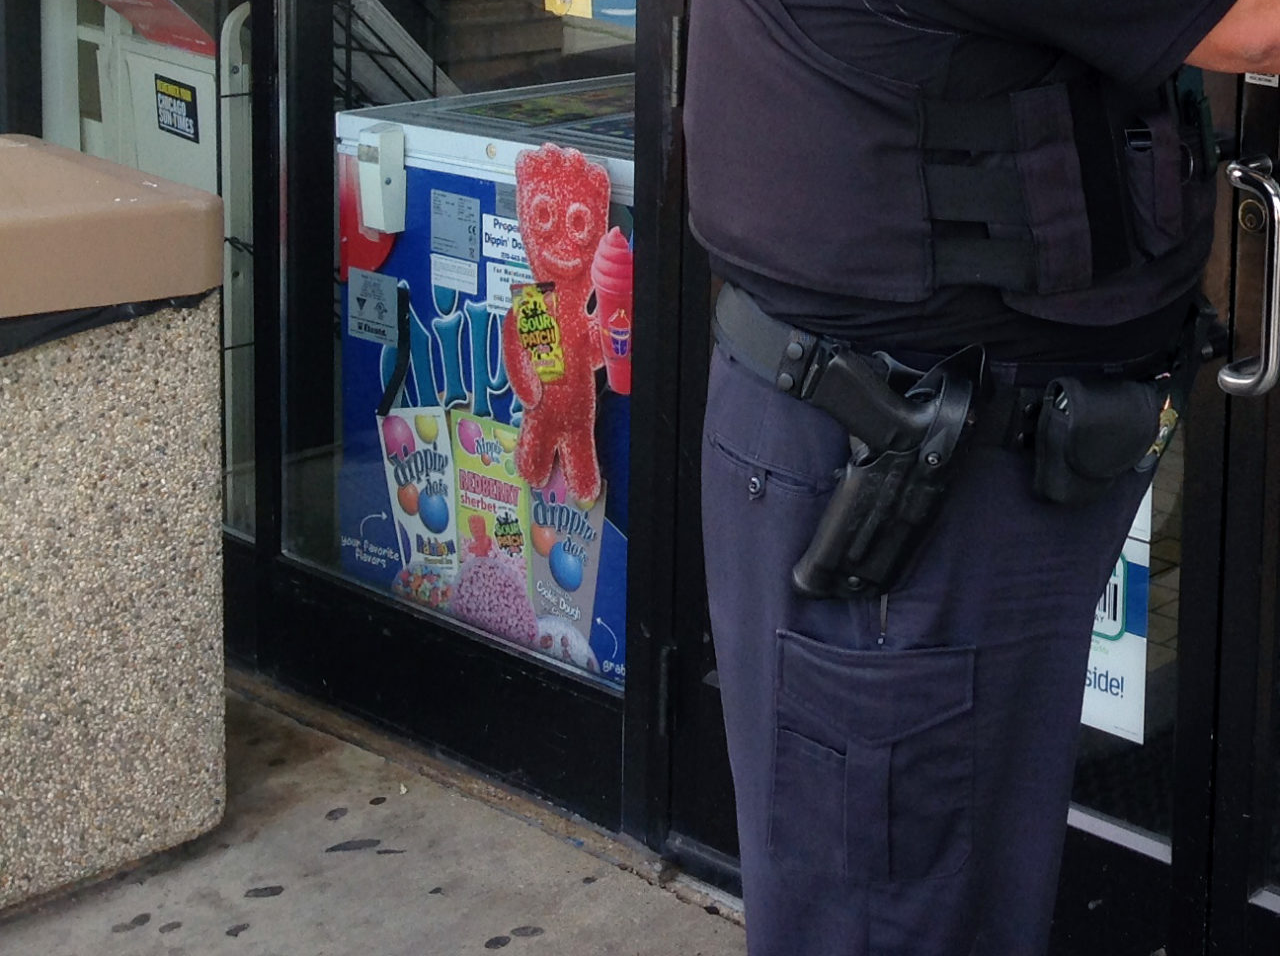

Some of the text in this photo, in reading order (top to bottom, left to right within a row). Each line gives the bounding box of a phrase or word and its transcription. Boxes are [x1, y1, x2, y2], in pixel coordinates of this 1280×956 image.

[520, 316, 551, 332] SOUR
[521, 329, 557, 347] PATCH
[460, 493, 497, 513] sherbet
[559, 597, 582, 621] Dough
